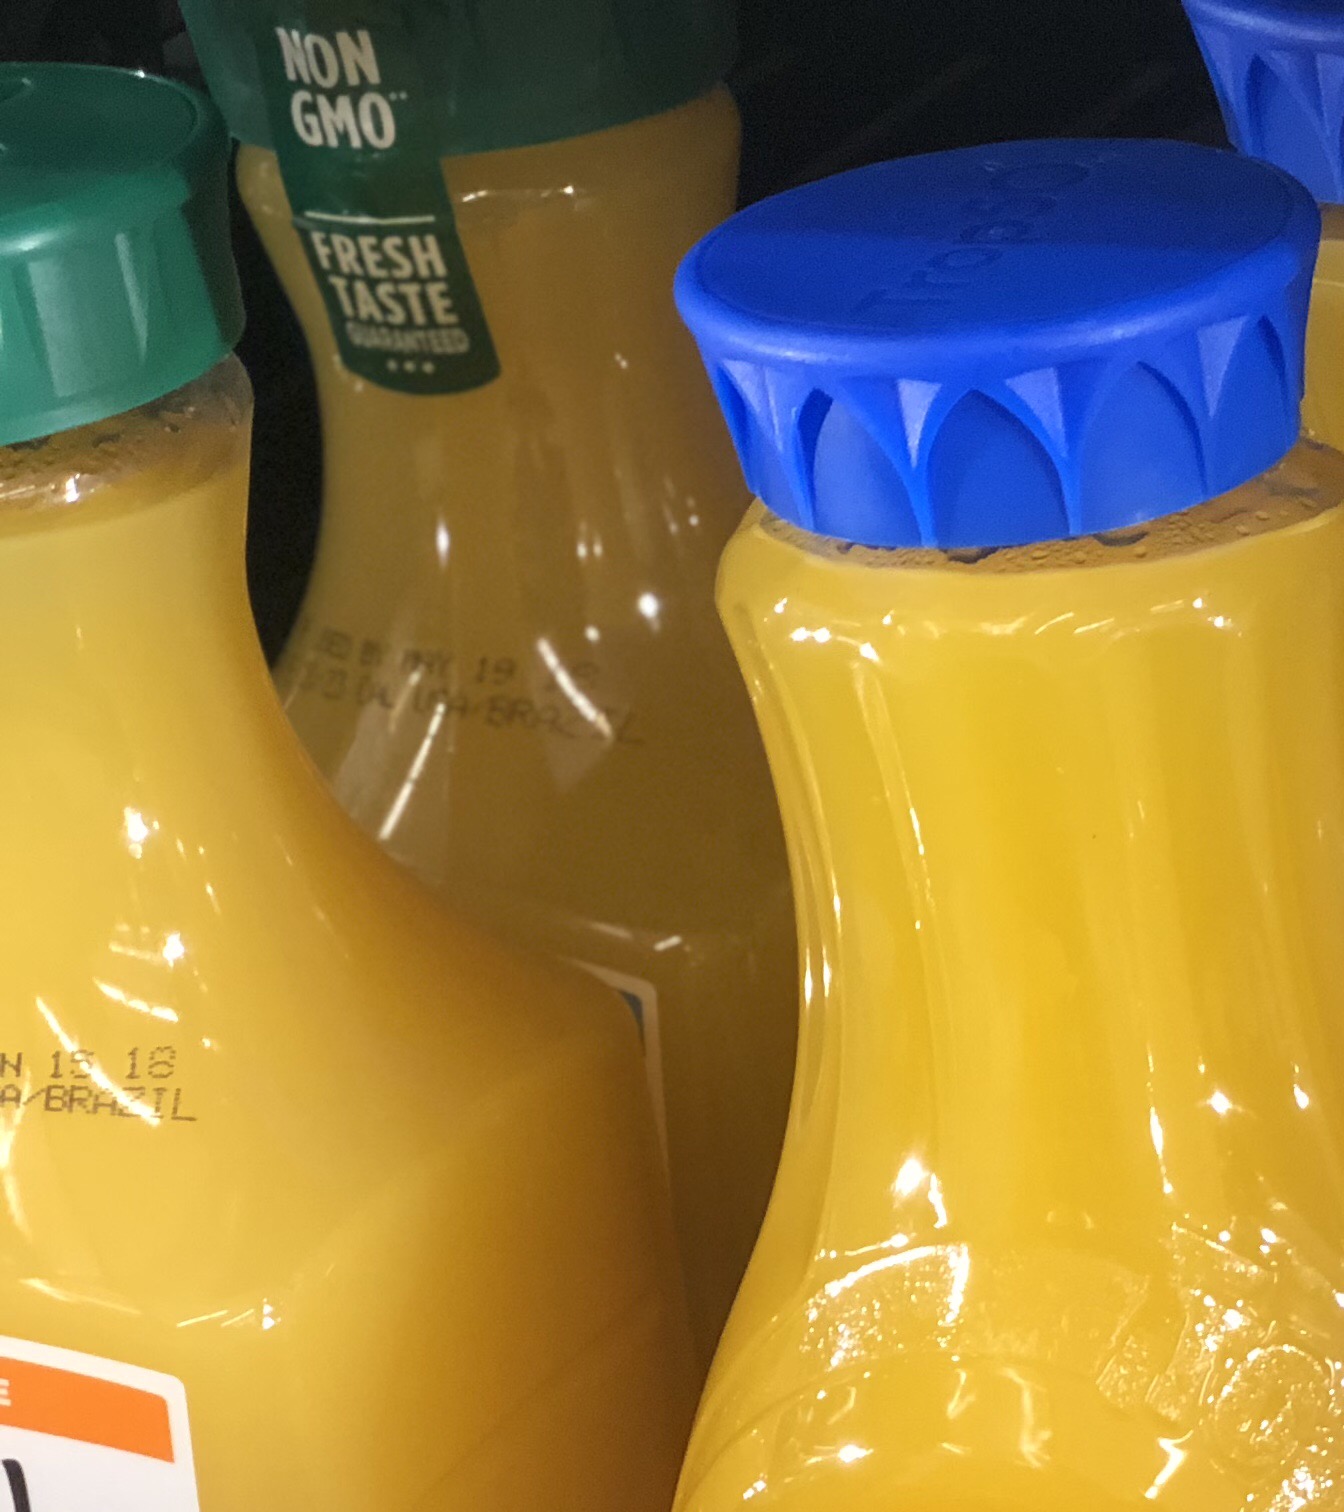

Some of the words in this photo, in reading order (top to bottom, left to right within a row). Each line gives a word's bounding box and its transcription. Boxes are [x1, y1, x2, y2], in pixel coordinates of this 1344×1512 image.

[276, 27, 381, 87] NON
[311, 231, 448, 279] FRESH
[328, 278, 458, 325] TASTE
[345, 322, 470, 354] GUARANTEED
[126, 1046, 177, 1080] 18
[0, 1083, 197, 1122] A/BRAZIL
